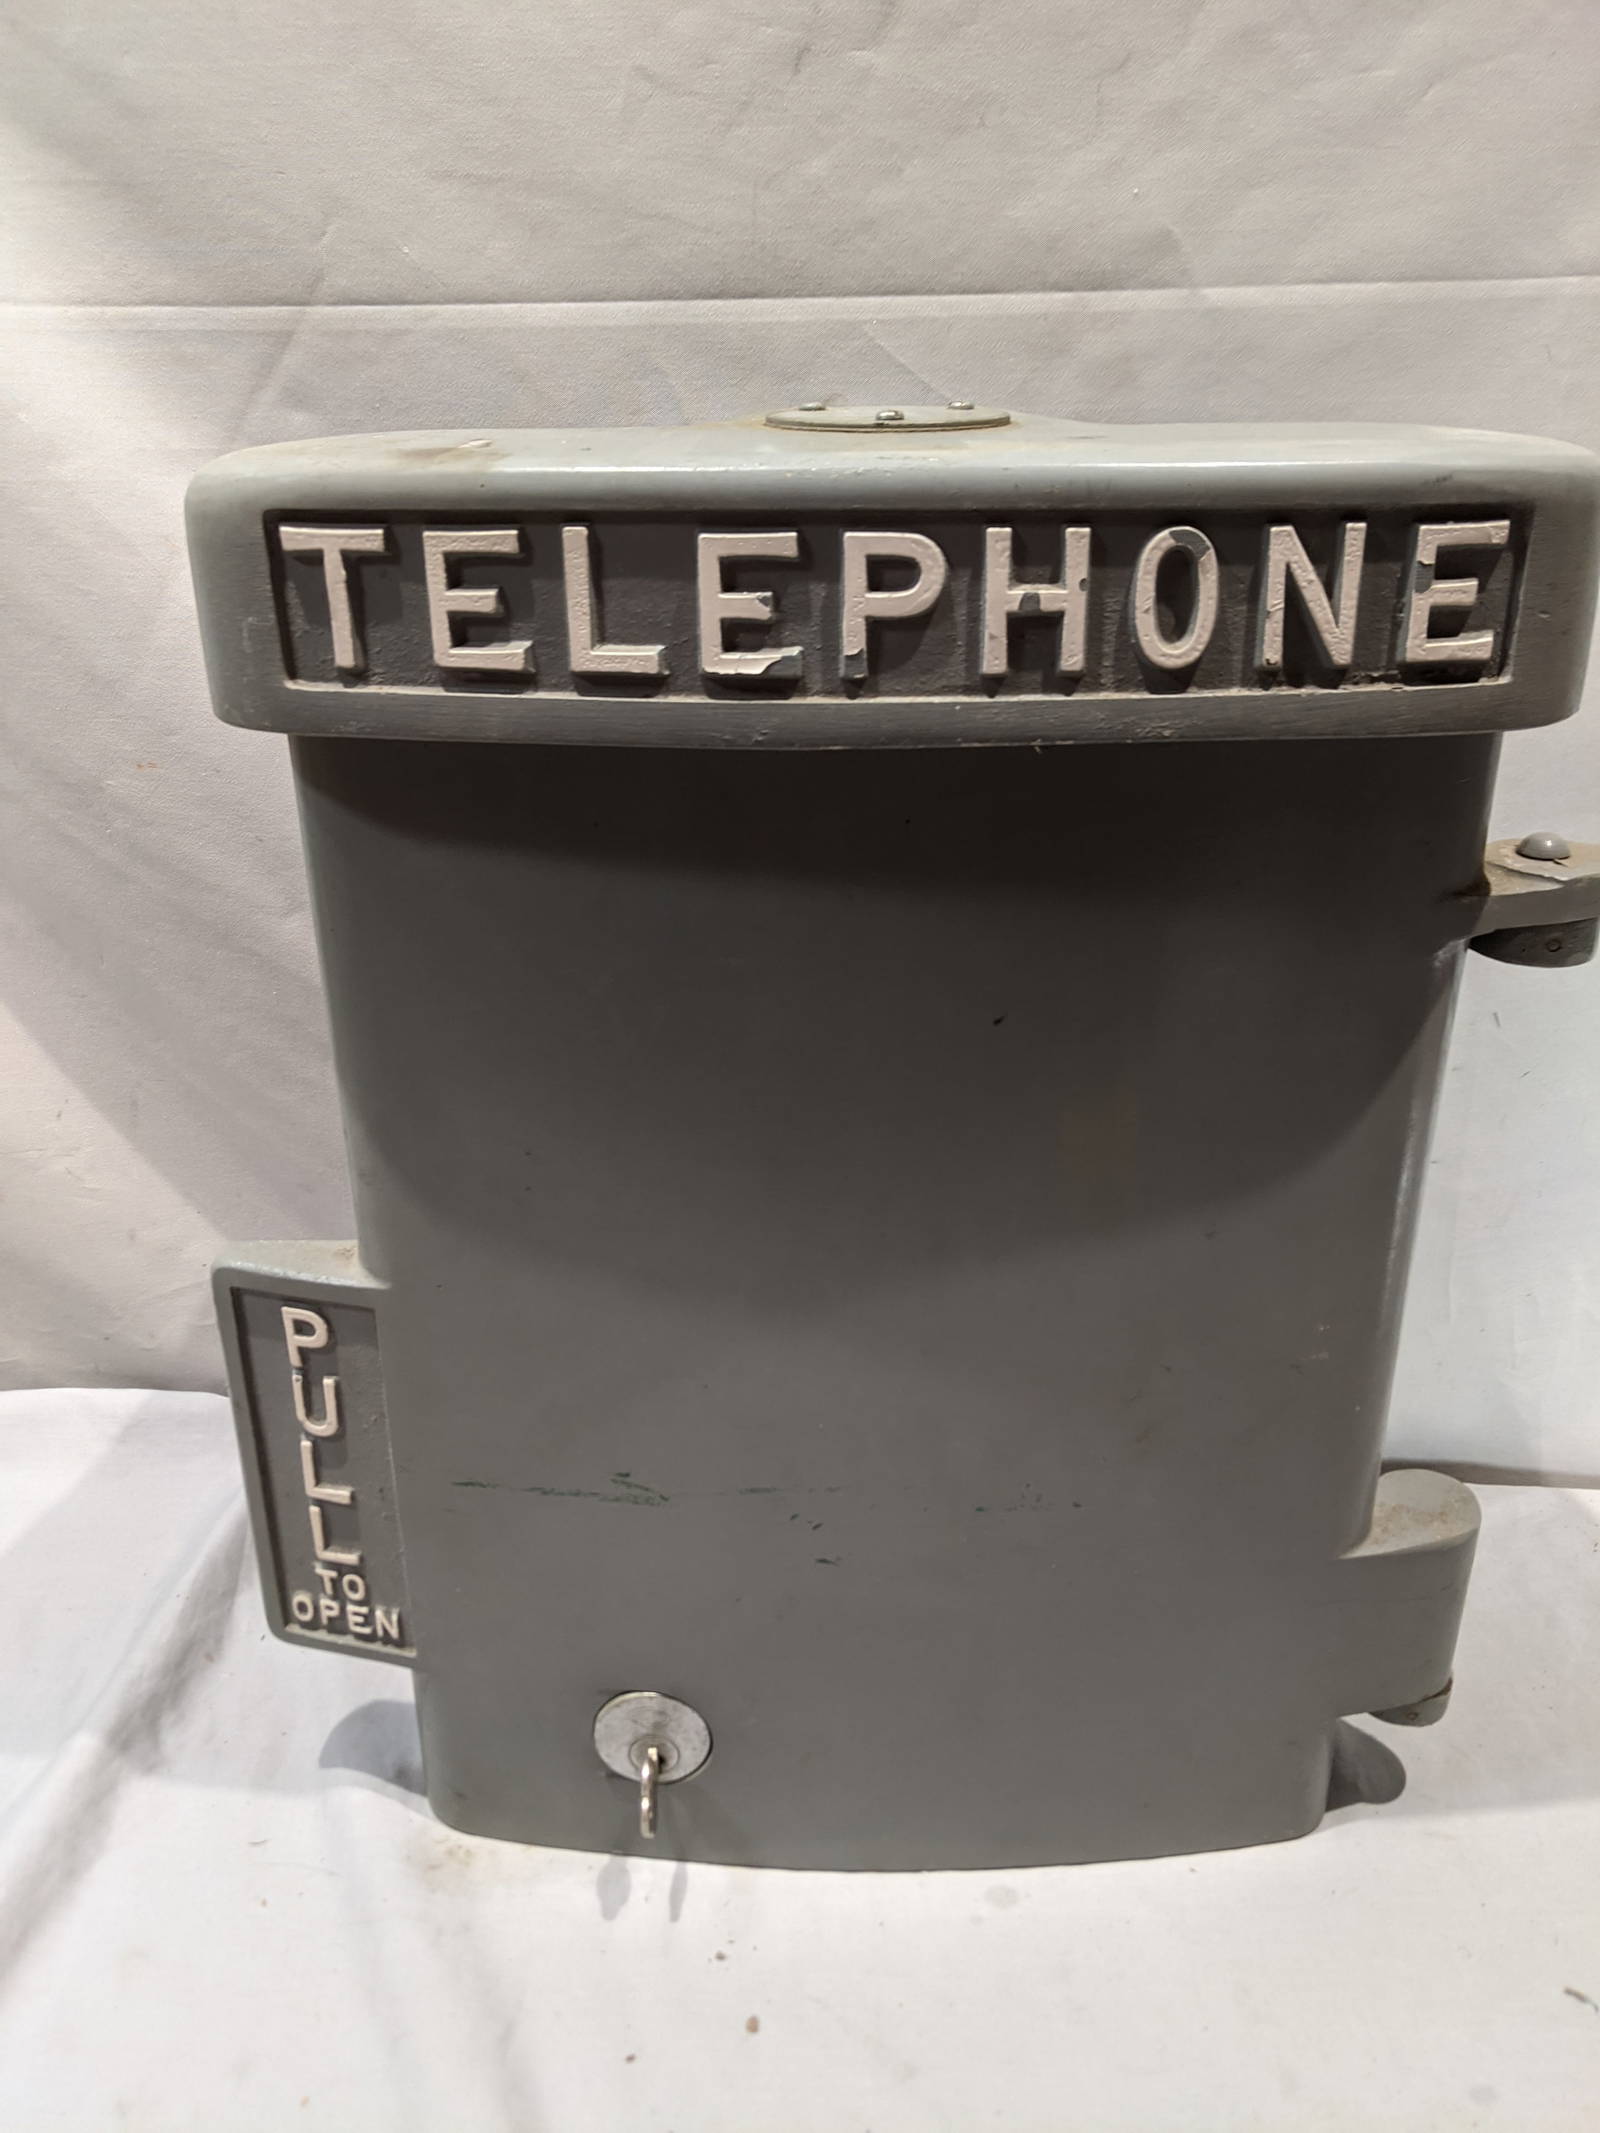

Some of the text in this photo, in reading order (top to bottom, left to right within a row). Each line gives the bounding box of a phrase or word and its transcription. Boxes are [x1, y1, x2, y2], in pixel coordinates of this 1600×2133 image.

[278, 520, 1510, 680] TELEPHONE
[280, 1306, 362, 1566] PULL
[291, 1594, 400, 1640] OPEN
[315, 1567, 366, 1600] TO
